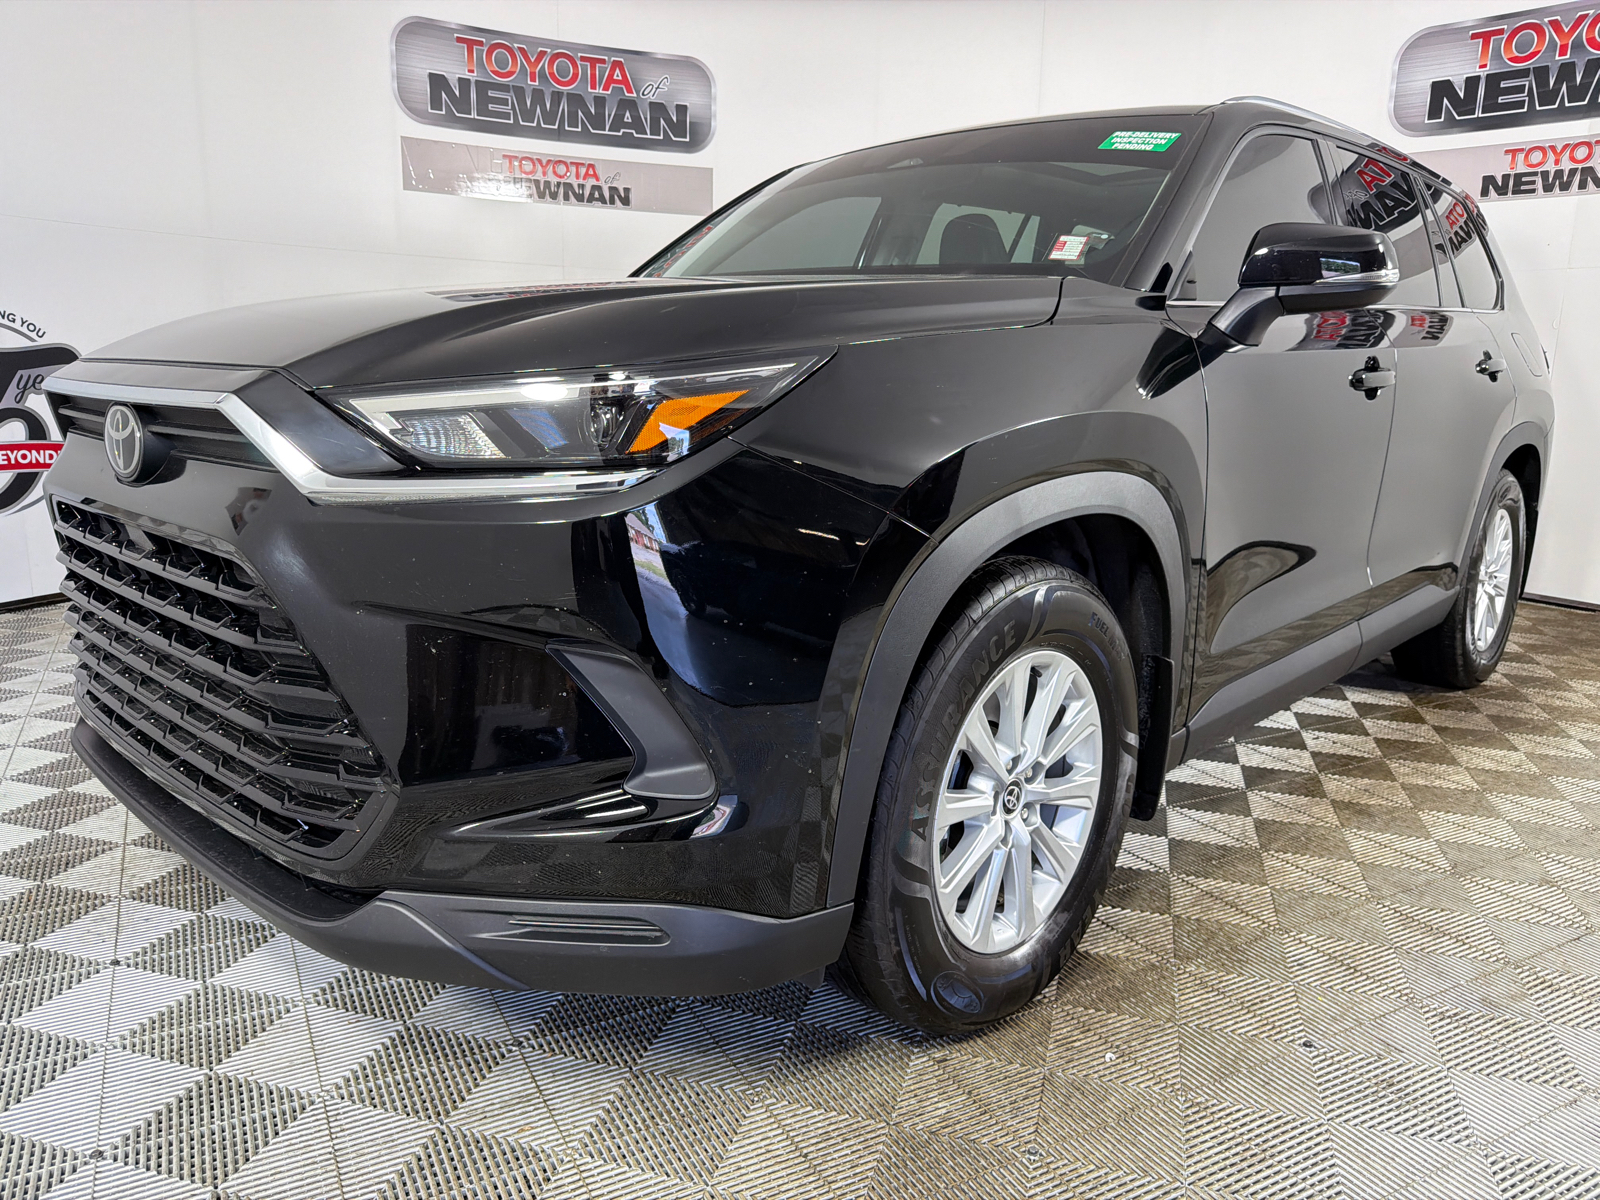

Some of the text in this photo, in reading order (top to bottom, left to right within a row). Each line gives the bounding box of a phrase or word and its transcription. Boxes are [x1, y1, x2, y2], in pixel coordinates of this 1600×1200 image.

[455, 34, 669, 99] TOYOTA of
[428, 72, 690, 141] NEWNAN
[1112, 131, 1178, 139] PRE-DELIVERY
[502, 154, 621, 185] TOYOTA of
[1504, 139, 1600, 170] TOYO
[20, 316, 46, 338] YOU
[1088, 611, 1110, 638] FUEL
[911, 619, 1016, 841] ASSURANCE
